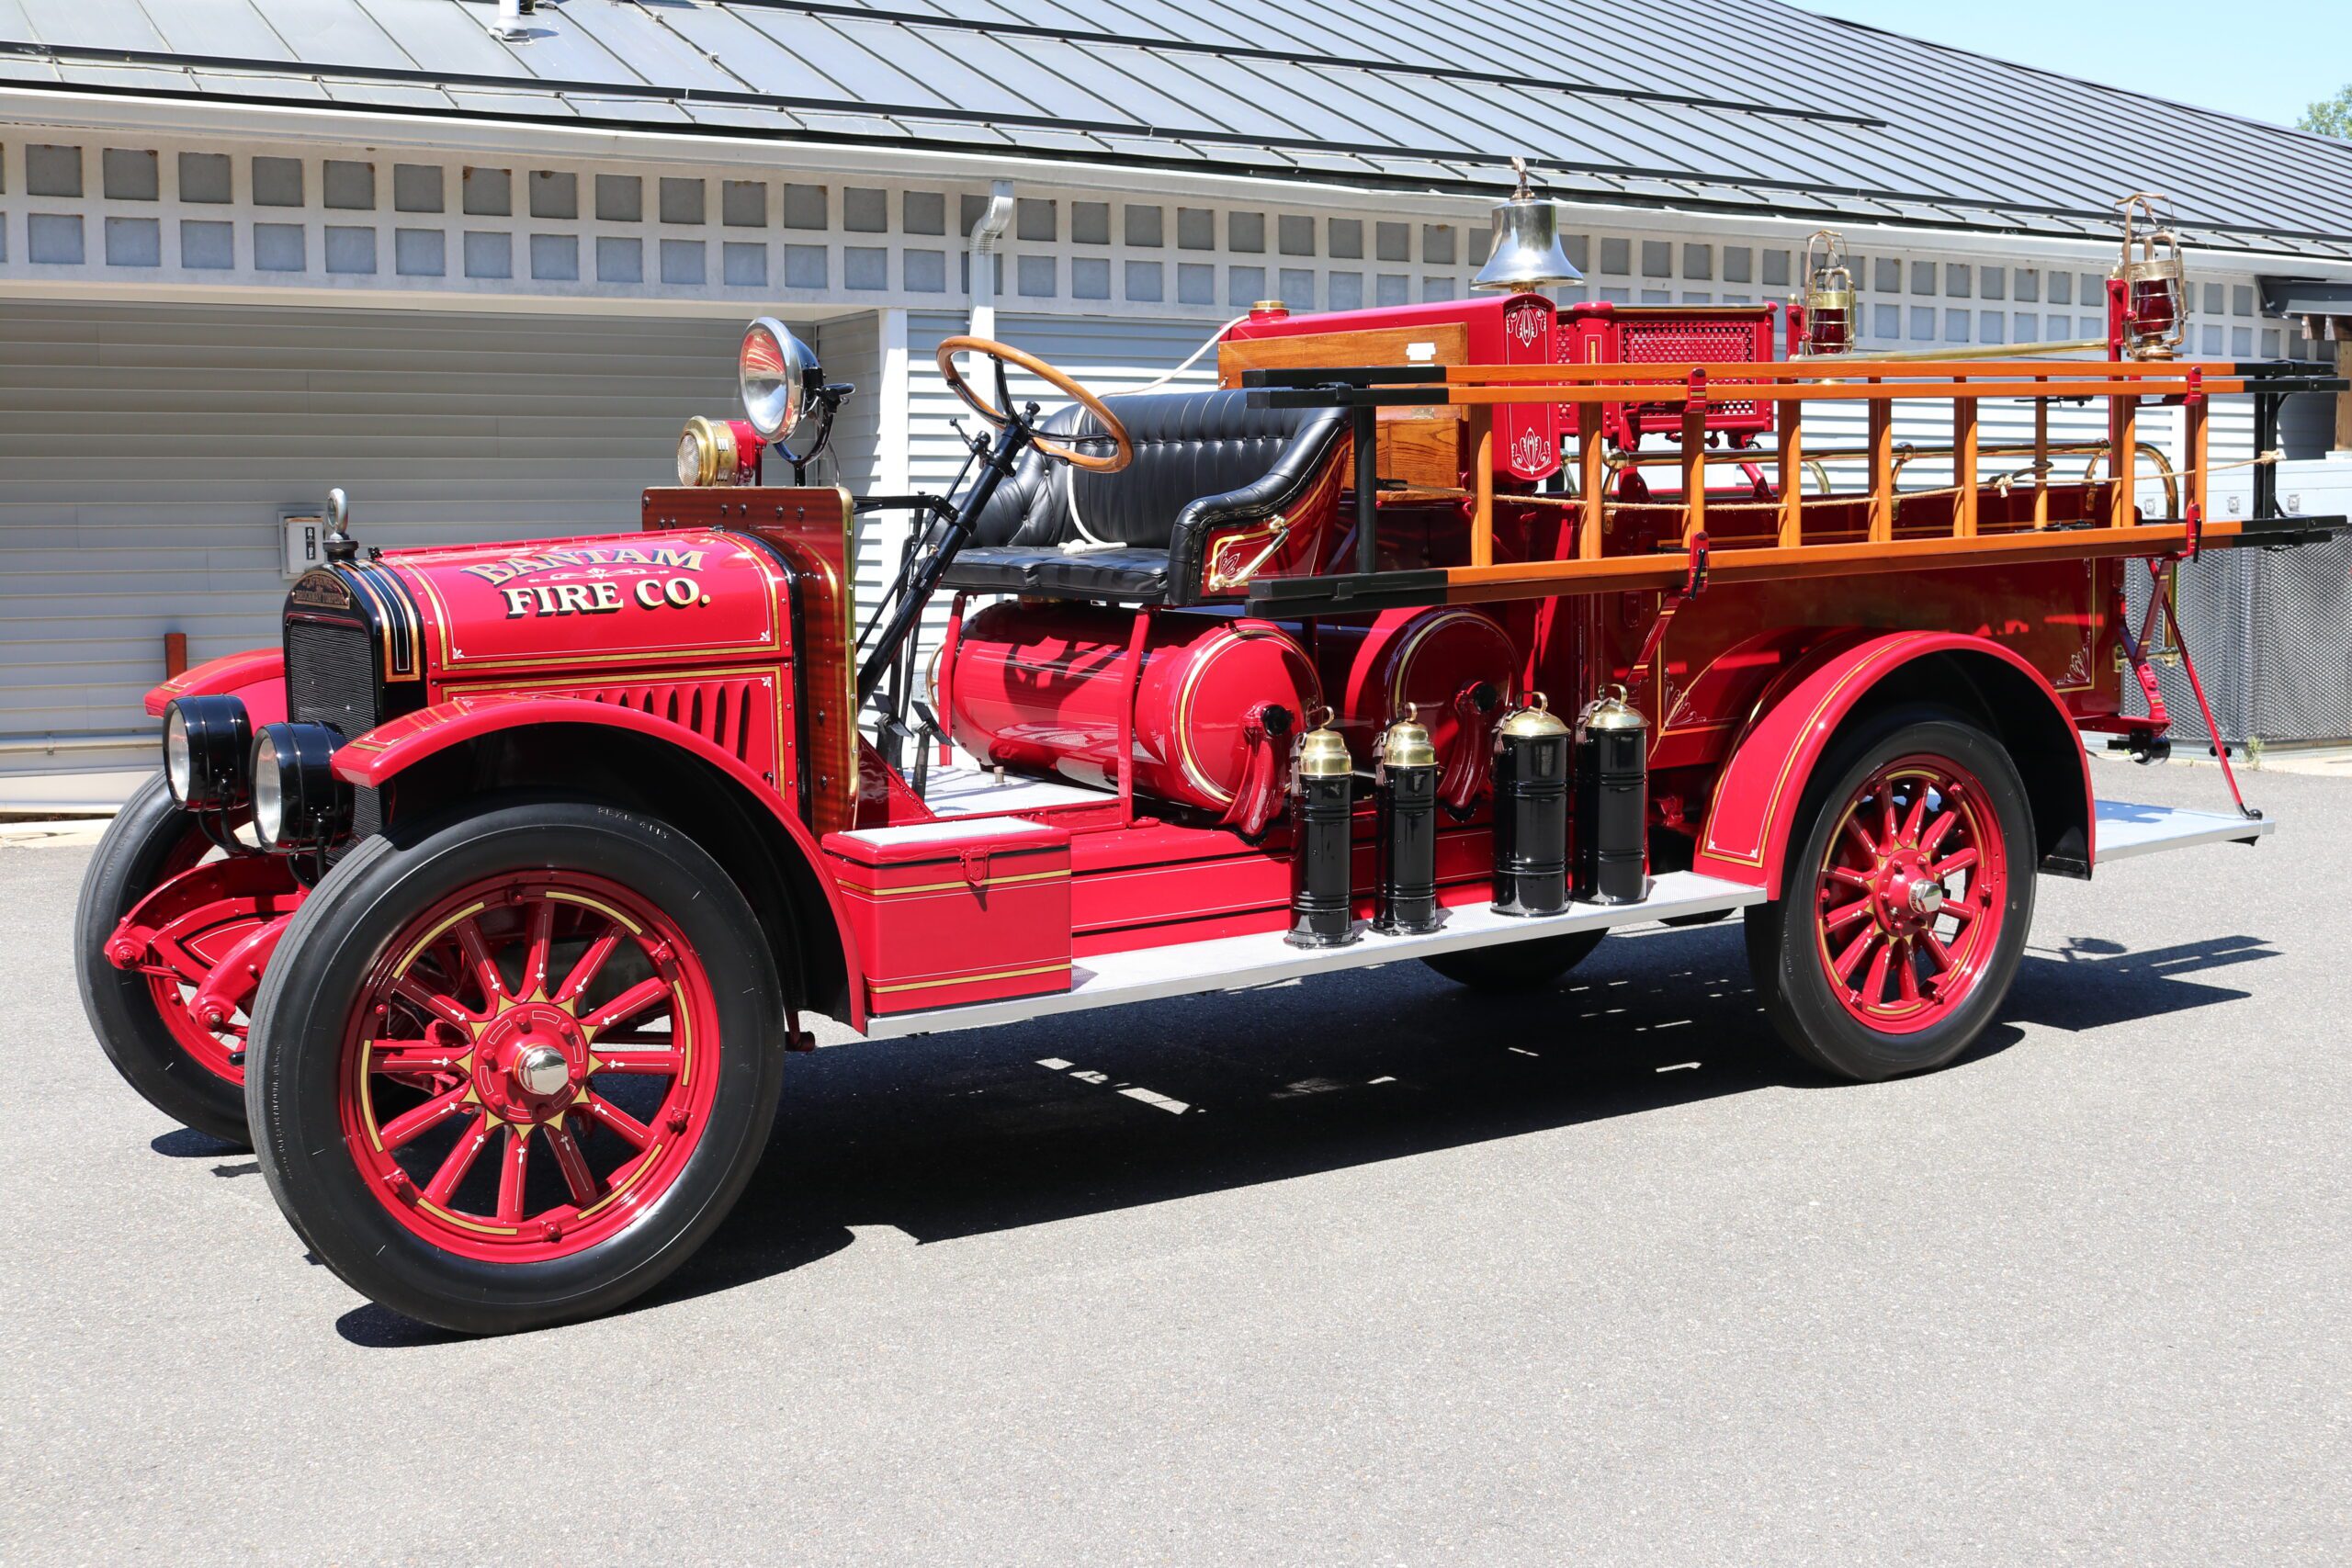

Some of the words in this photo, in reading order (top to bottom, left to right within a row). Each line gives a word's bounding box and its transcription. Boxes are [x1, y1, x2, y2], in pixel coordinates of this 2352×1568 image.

[459, 548, 709, 588] BANTAM
[501, 581, 624, 618] FIRE
[634, 577, 711, 609] CO.
